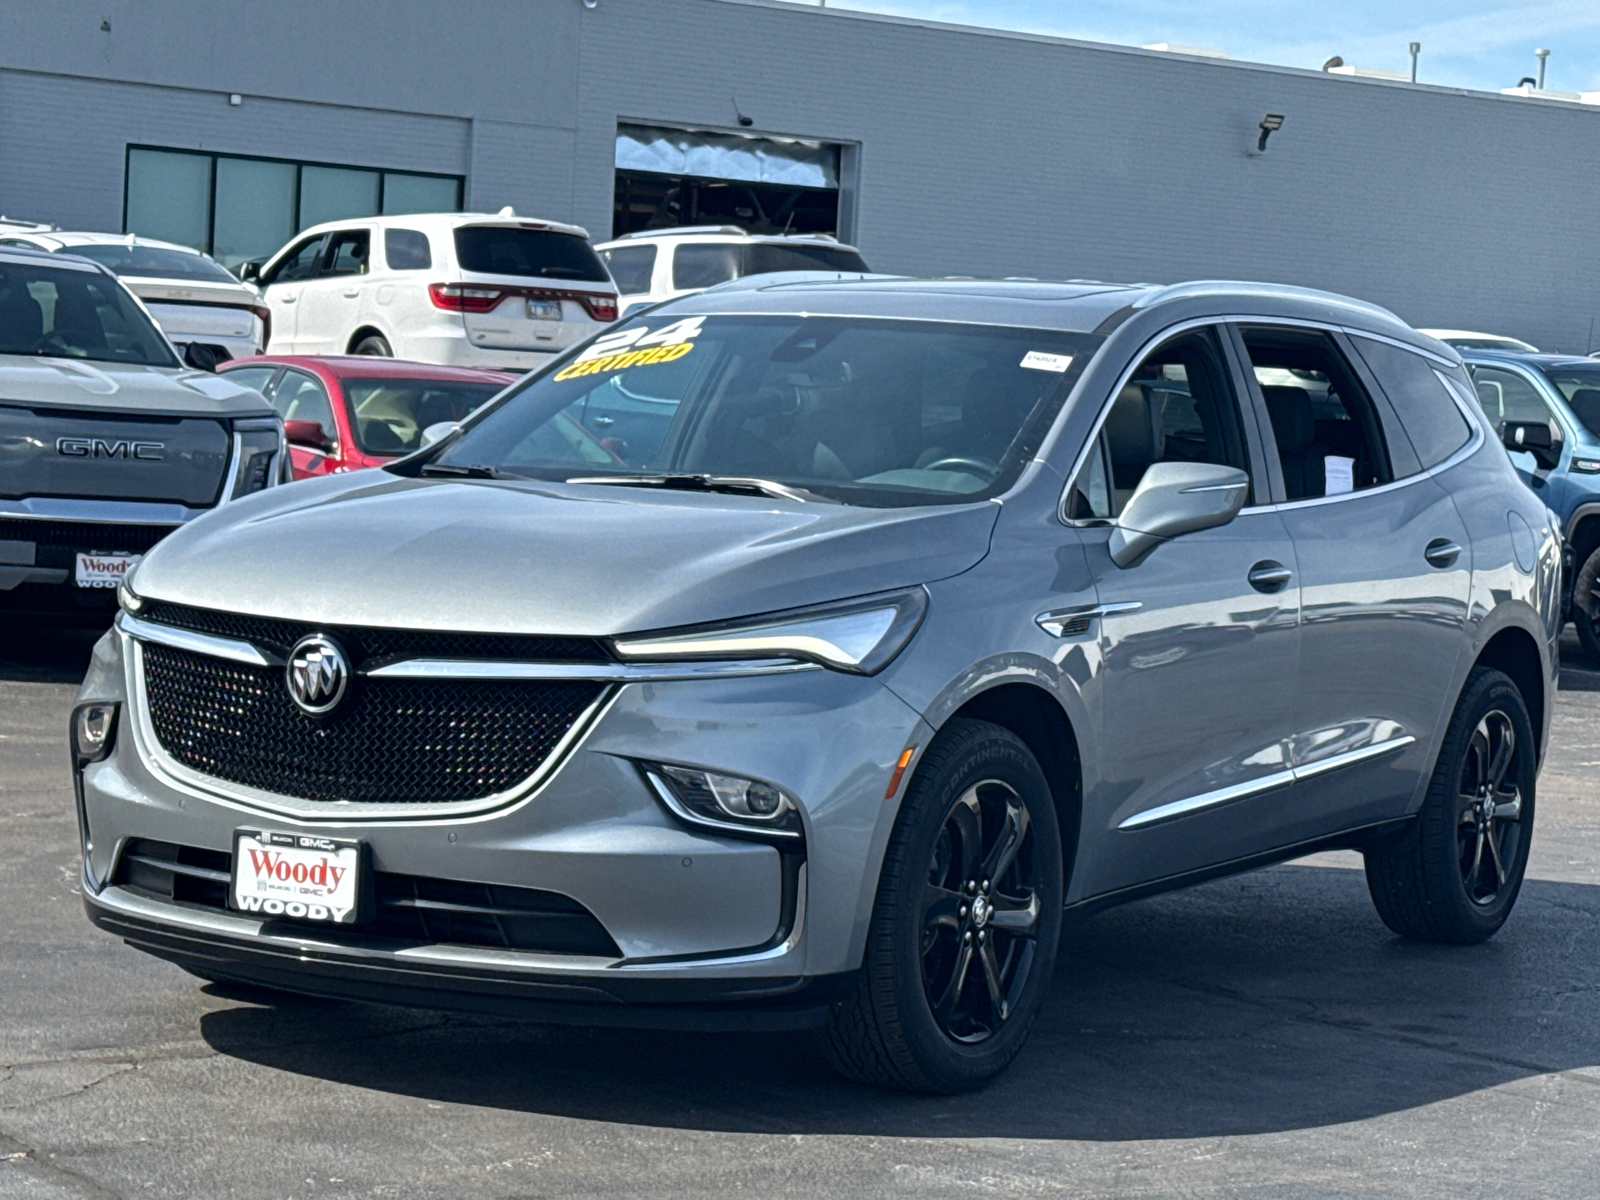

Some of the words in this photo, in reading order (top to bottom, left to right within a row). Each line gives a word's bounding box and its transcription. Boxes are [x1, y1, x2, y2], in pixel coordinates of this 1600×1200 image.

[574, 316, 707, 363] 24
[553, 342, 694, 382] CERTIFIED
[56, 436, 165, 461] GMC
[941, 746, 1031, 804] CONTINENTAL
[299, 837, 331, 849] GMC
[247, 848, 347, 895] Woody
[238, 895, 352, 923] WOODY
